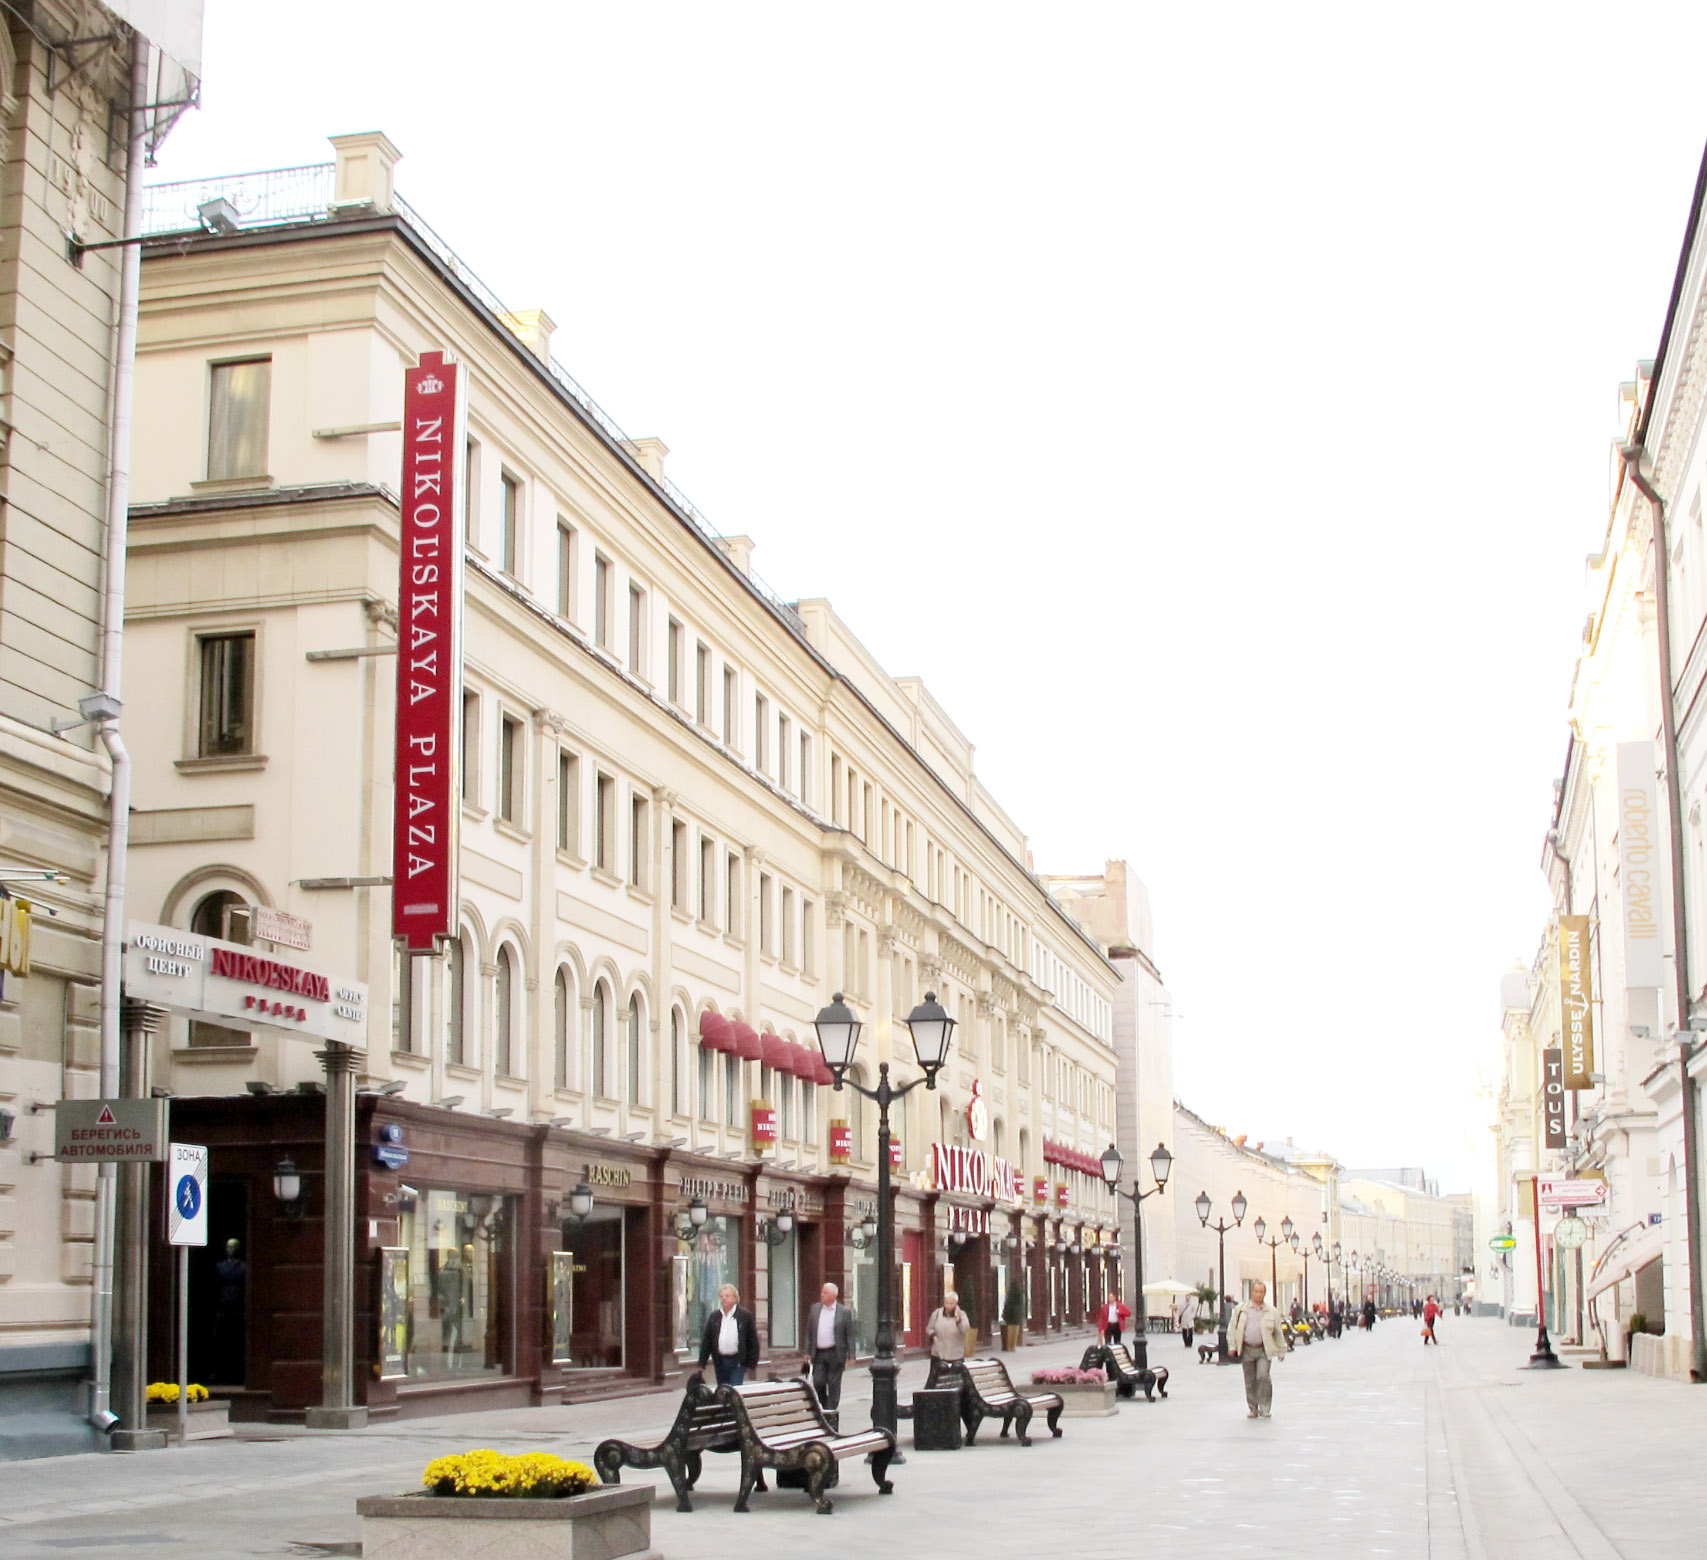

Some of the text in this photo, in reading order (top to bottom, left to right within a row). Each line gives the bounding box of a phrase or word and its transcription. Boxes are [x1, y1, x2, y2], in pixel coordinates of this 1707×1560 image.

[408, 732, 437, 879] PLAZA
[1624, 788, 1658, 940] roberto cavalli
[137, 934, 204, 961] ОФИСНЫЙ
[147, 956, 193, 978] ЦЕНТР
[245, 995, 307, 1022] PLAZA
[1569, 930, 1584, 1075] ULYSSE NARDIN
[1547, 1062, 1563, 1135] TOUS
[71, 1128, 141, 1141] БЕРЕГИСЬ
[60, 1144, 153, 1157] АВТОМОБИЛЯ
[176, 1149, 201, 1161] ЗОНА
